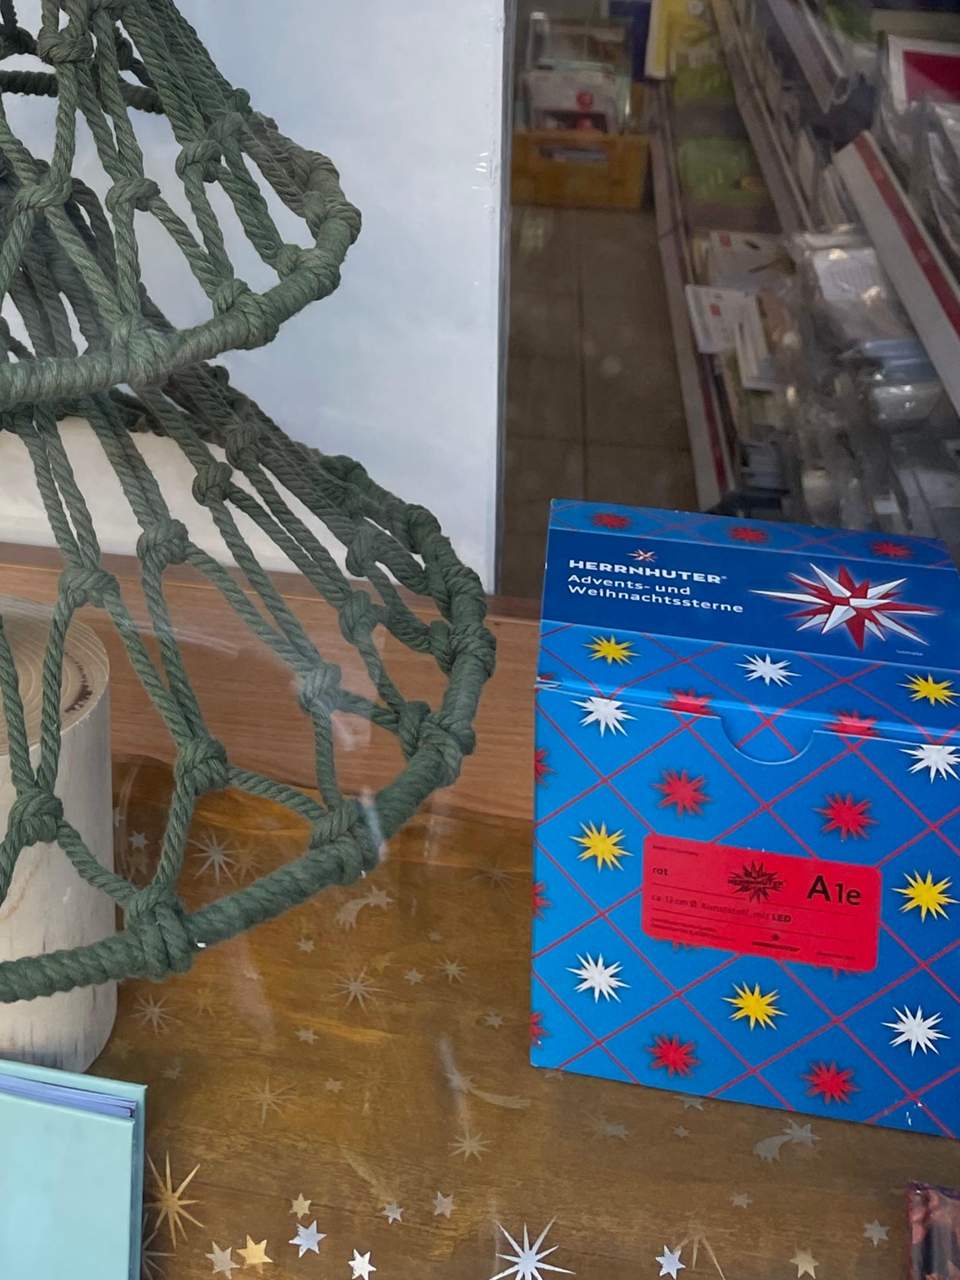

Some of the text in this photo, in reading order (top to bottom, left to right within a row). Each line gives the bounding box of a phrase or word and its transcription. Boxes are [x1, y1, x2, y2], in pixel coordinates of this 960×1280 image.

[567, 574, 691, 596] Advents- und
[567, 585, 744, 613] Weihnachtssterne
[771, 913, 792, 924] LED
